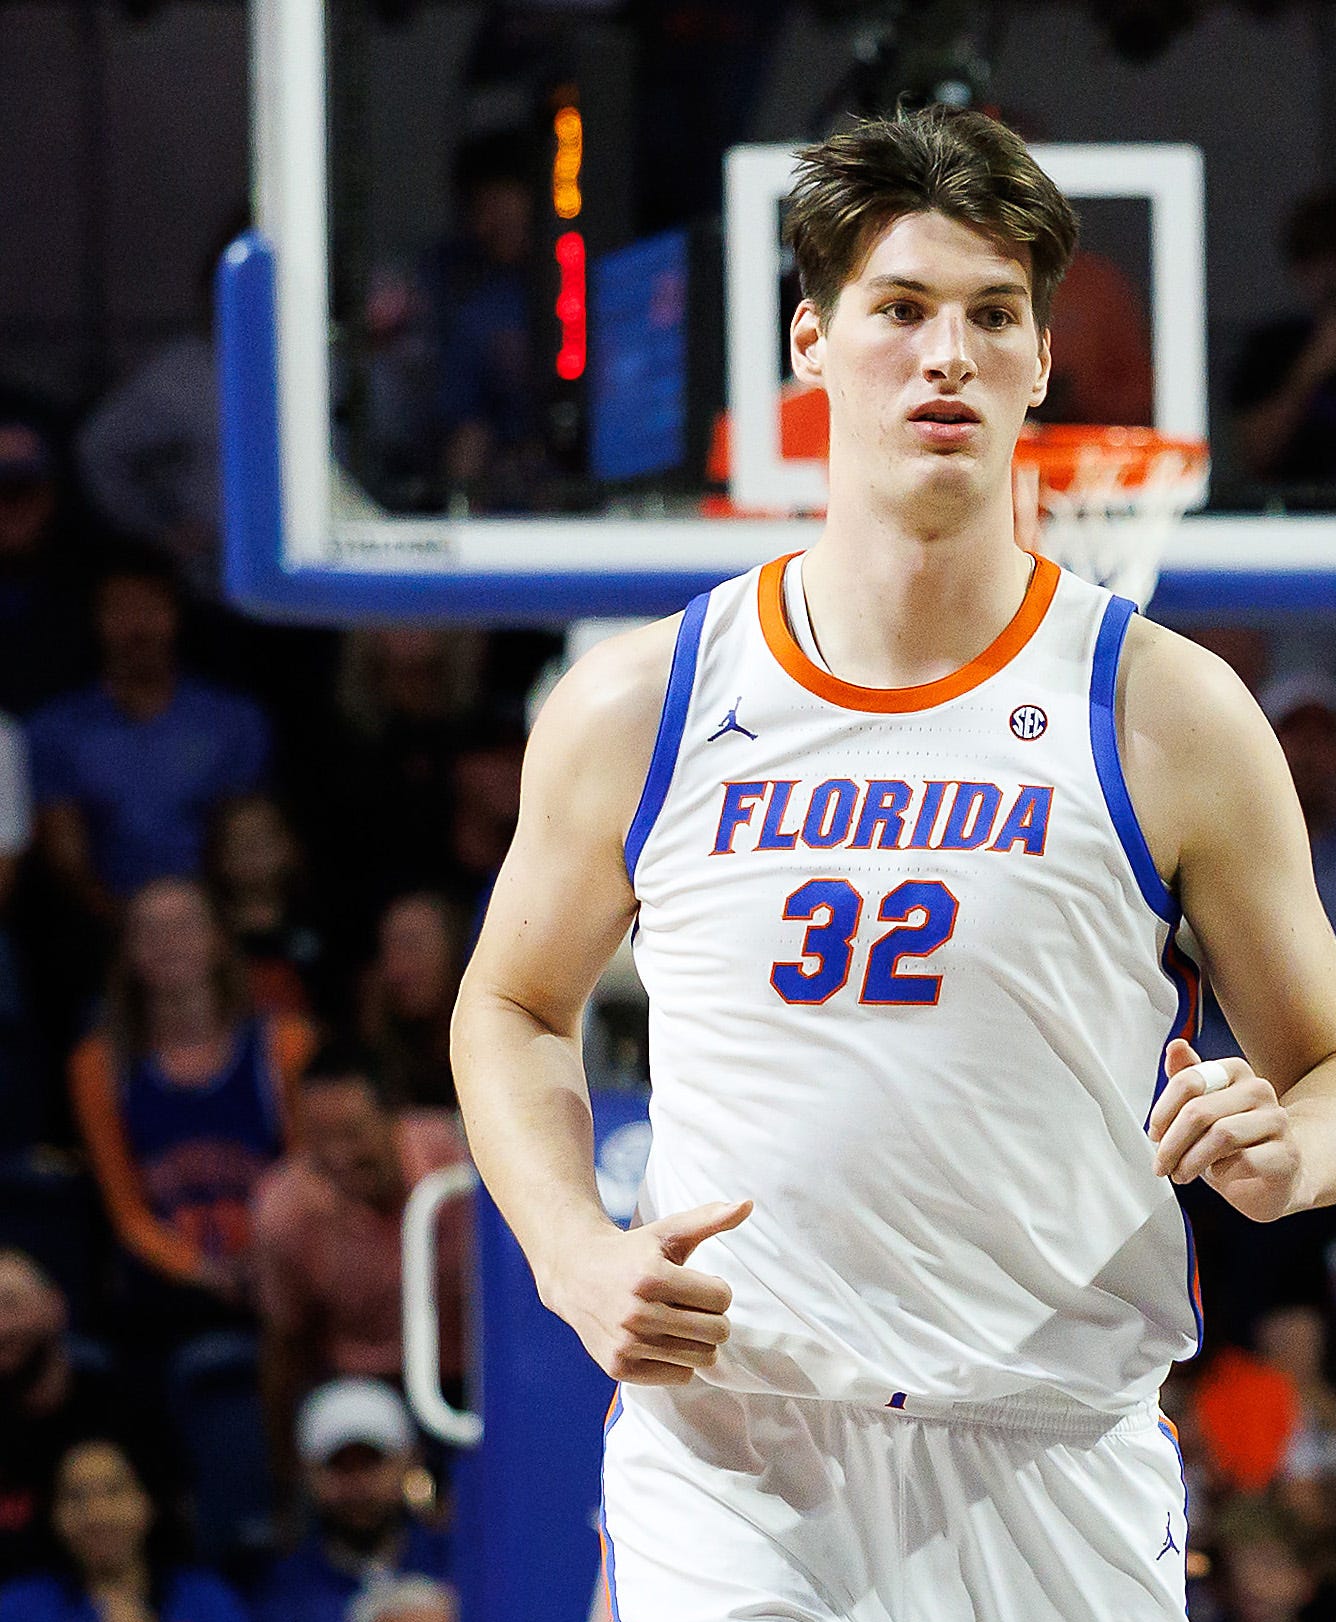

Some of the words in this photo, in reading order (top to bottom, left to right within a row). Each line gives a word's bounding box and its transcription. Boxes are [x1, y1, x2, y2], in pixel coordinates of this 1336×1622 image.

[1012, 706, 1045, 739] SEC
[708, 778, 1054, 856] FLORIDA
[769, 877, 959, 1006] 32
